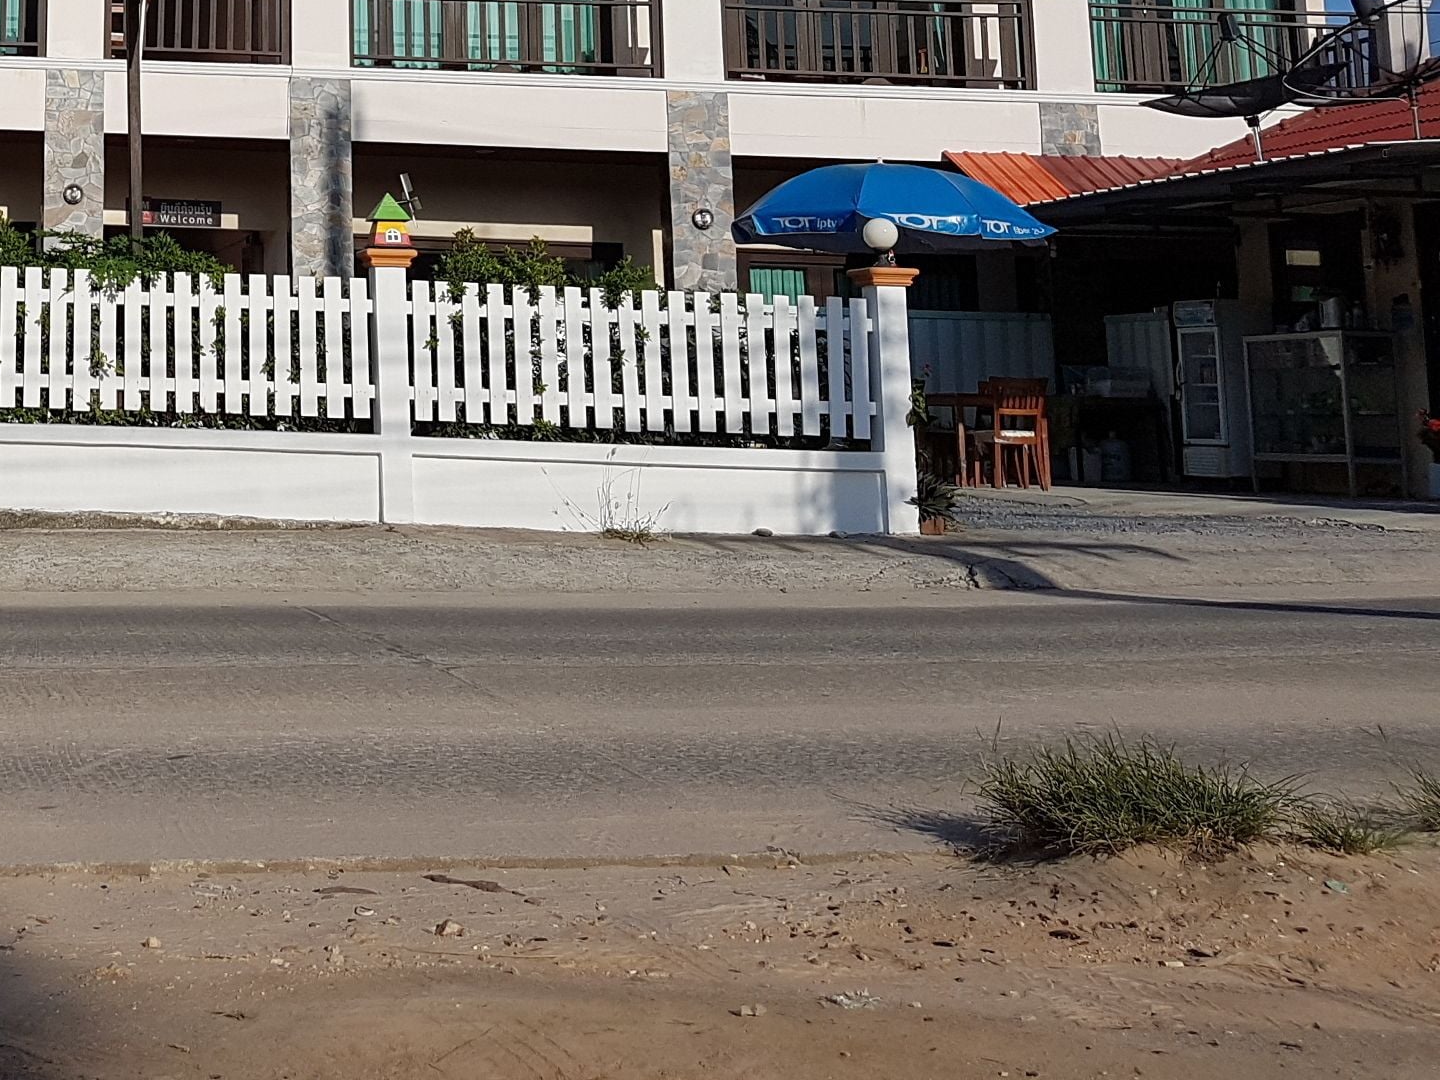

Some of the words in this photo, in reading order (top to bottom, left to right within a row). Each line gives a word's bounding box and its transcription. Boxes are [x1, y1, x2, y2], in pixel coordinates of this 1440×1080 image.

[160, 201, 213, 215] ยินดีต้อนรับ
[160, 214, 213, 224] Welcome
[771, 216, 817, 229] TOT
[880, 212, 954, 230] TOT
[981, 219, 1012, 234] TOT
